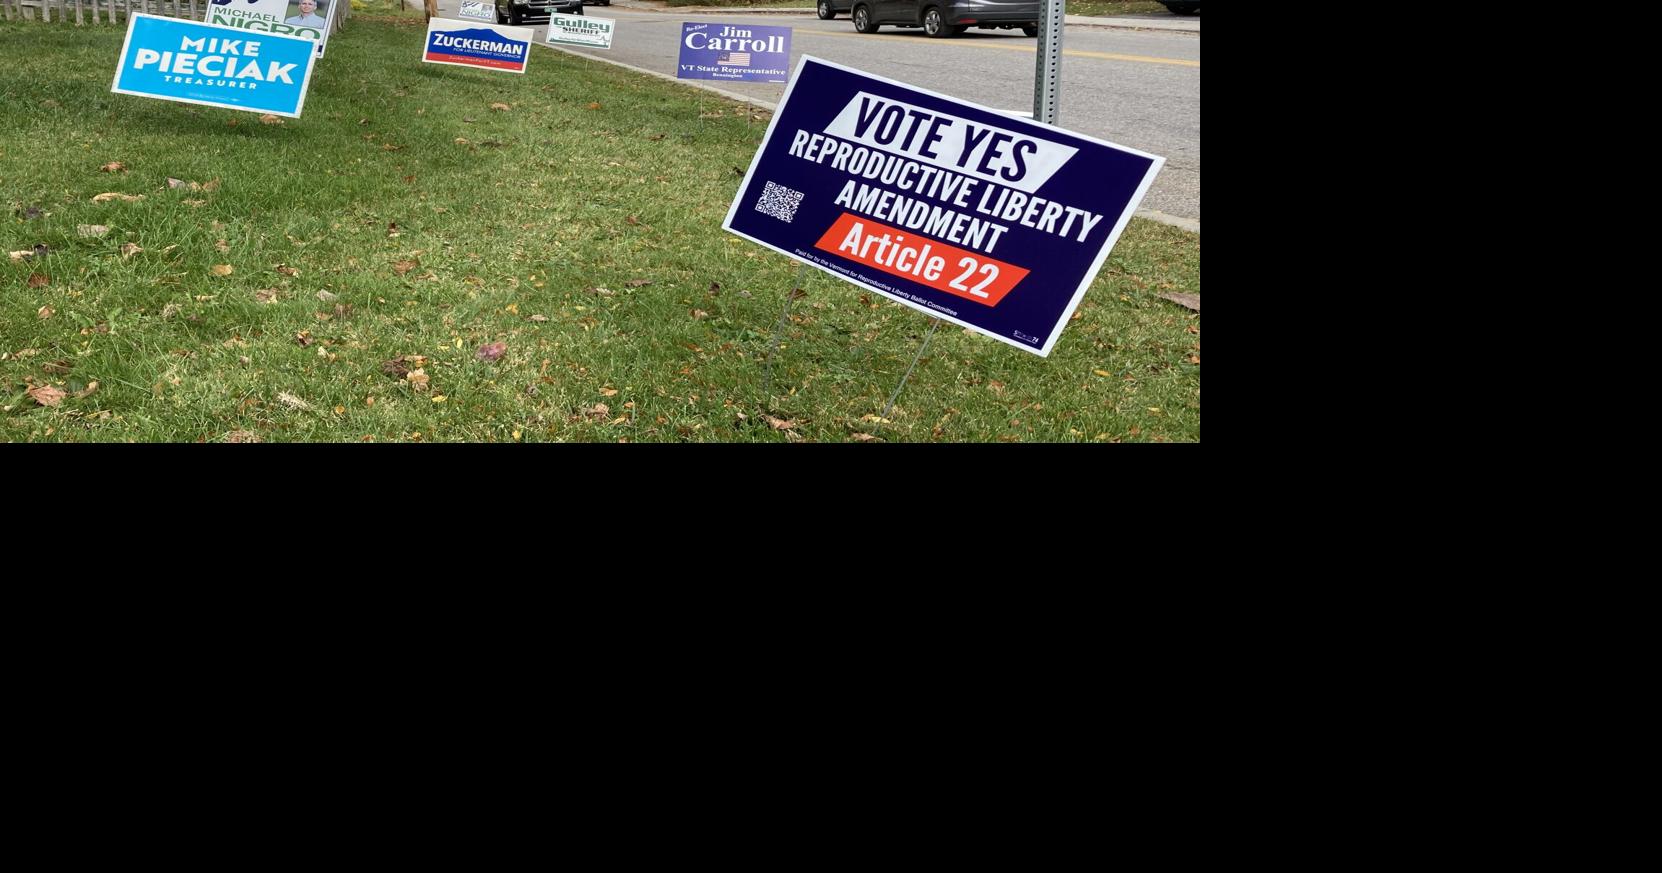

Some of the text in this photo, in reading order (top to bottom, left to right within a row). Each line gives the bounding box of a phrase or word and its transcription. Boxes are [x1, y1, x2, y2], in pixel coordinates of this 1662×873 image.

[214, 7, 280, 22] MICHAEL
[553, 17, 610, 33] Gulley
[686, 24, 708, 32] Re-Elect
[720, 26, 752, 38] Jim
[180, 35, 261, 57] MIKE
[433, 33, 523, 54] ZUCKERMAN
[685, 32, 785, 53] Carroll
[133, 48, 298, 85] PIECIAK
[721, 66, 786, 75] Representative
[164, 75, 257, 90] TREASURER
[854, 97, 1038, 182] VOTE YES
[788, 129, 1104, 243] REPRODUCTIVE LIBERTY
[834, 180, 1009, 254] AMENDMENT
[838, 222, 1000, 299] Article 22
[795, 248, 806, 257] Paid
[829, 262, 850, 275] Vermont
[857, 273, 892, 292] Reproductive
[891, 287, 911, 299] Liberty
[910, 294, 927, 305] Ballot
[927, 301, 958, 316] Committee
